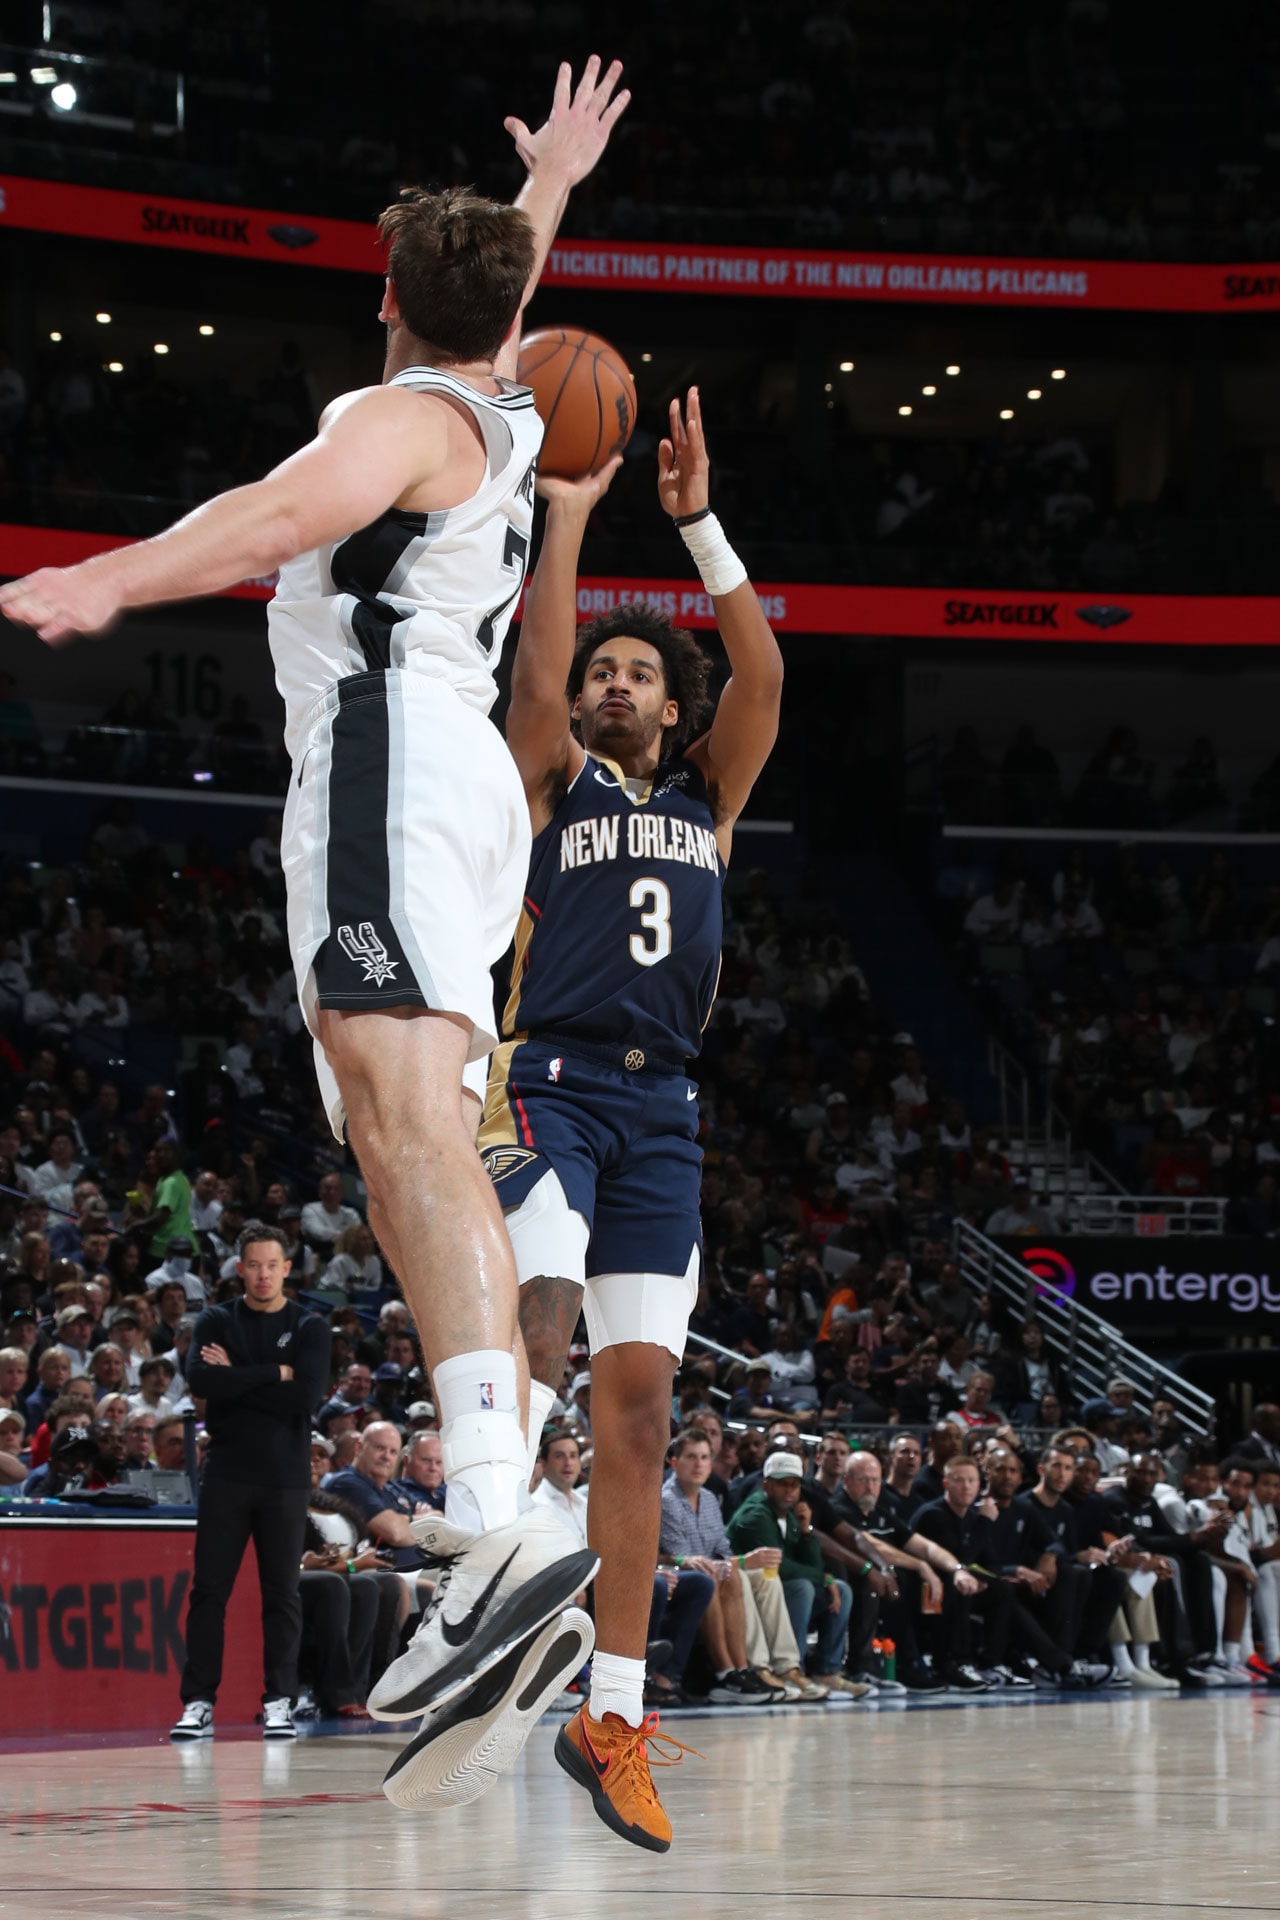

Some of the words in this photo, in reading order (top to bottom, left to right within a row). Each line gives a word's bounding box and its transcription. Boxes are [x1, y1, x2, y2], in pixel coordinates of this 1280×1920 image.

[142, 207, 249, 243] SEATGEEK
[551, 251, 659, 278] TICKETING
[664, 256, 758, 283] PARTNER
[764, 261, 788, 285] OF
[796, 262, 831, 286] THE
[837, 264, 882, 289] NEW
[888, 266, 982, 292] ORLEANS
[988, 270, 1087, 296] PELICANS
[681, 592, 785, 619] PELNS
[944, 601, 1058, 628] SEATGEEK
[144, 650, 223, 721] 116
[560, 813, 621, 873] NEW
[627, 813, 719, 878] ORLEANS
[629, 876, 672, 967] 3
[1090, 1265, 1280, 1313] entergy
